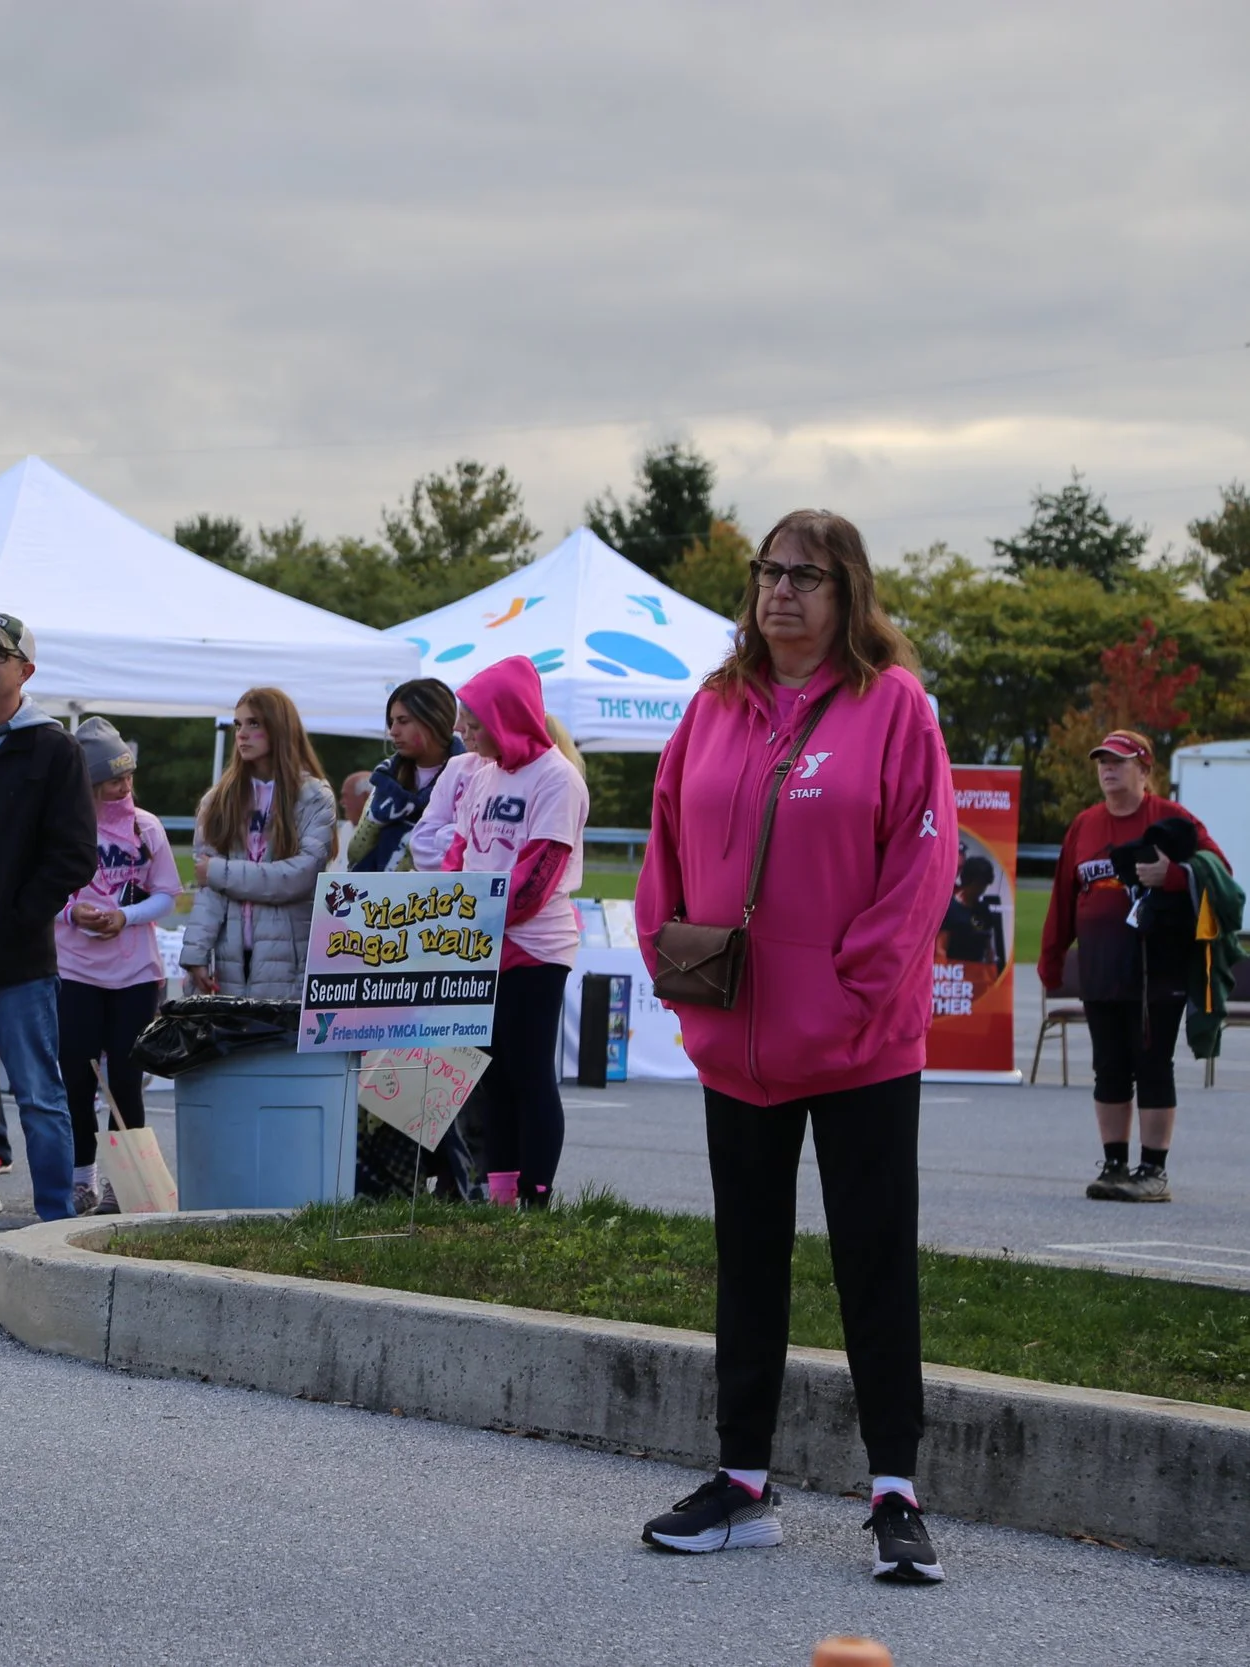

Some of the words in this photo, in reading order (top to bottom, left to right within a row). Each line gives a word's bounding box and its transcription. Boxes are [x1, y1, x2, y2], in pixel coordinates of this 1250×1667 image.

[598, 697, 631, 718] THE
[634, 699, 682, 720] YMCA
[789, 788, 822, 800] STAFF
[974, 799, 1011, 810] LIVING
[326, 929, 409, 967] angel
[933, 964, 964, 981] ING
[309, 979, 358, 1002] Second
[362, 977, 419, 1003] Saturday
[423, 976, 437, 999] of
[440, 975, 491, 999] October
[332, 1025, 385, 1042] Friendship
[387, 1024, 417, 1038] YMCA
[419, 1023, 450, 1037] Lower
[452, 1022, 487, 1036] Paxton
